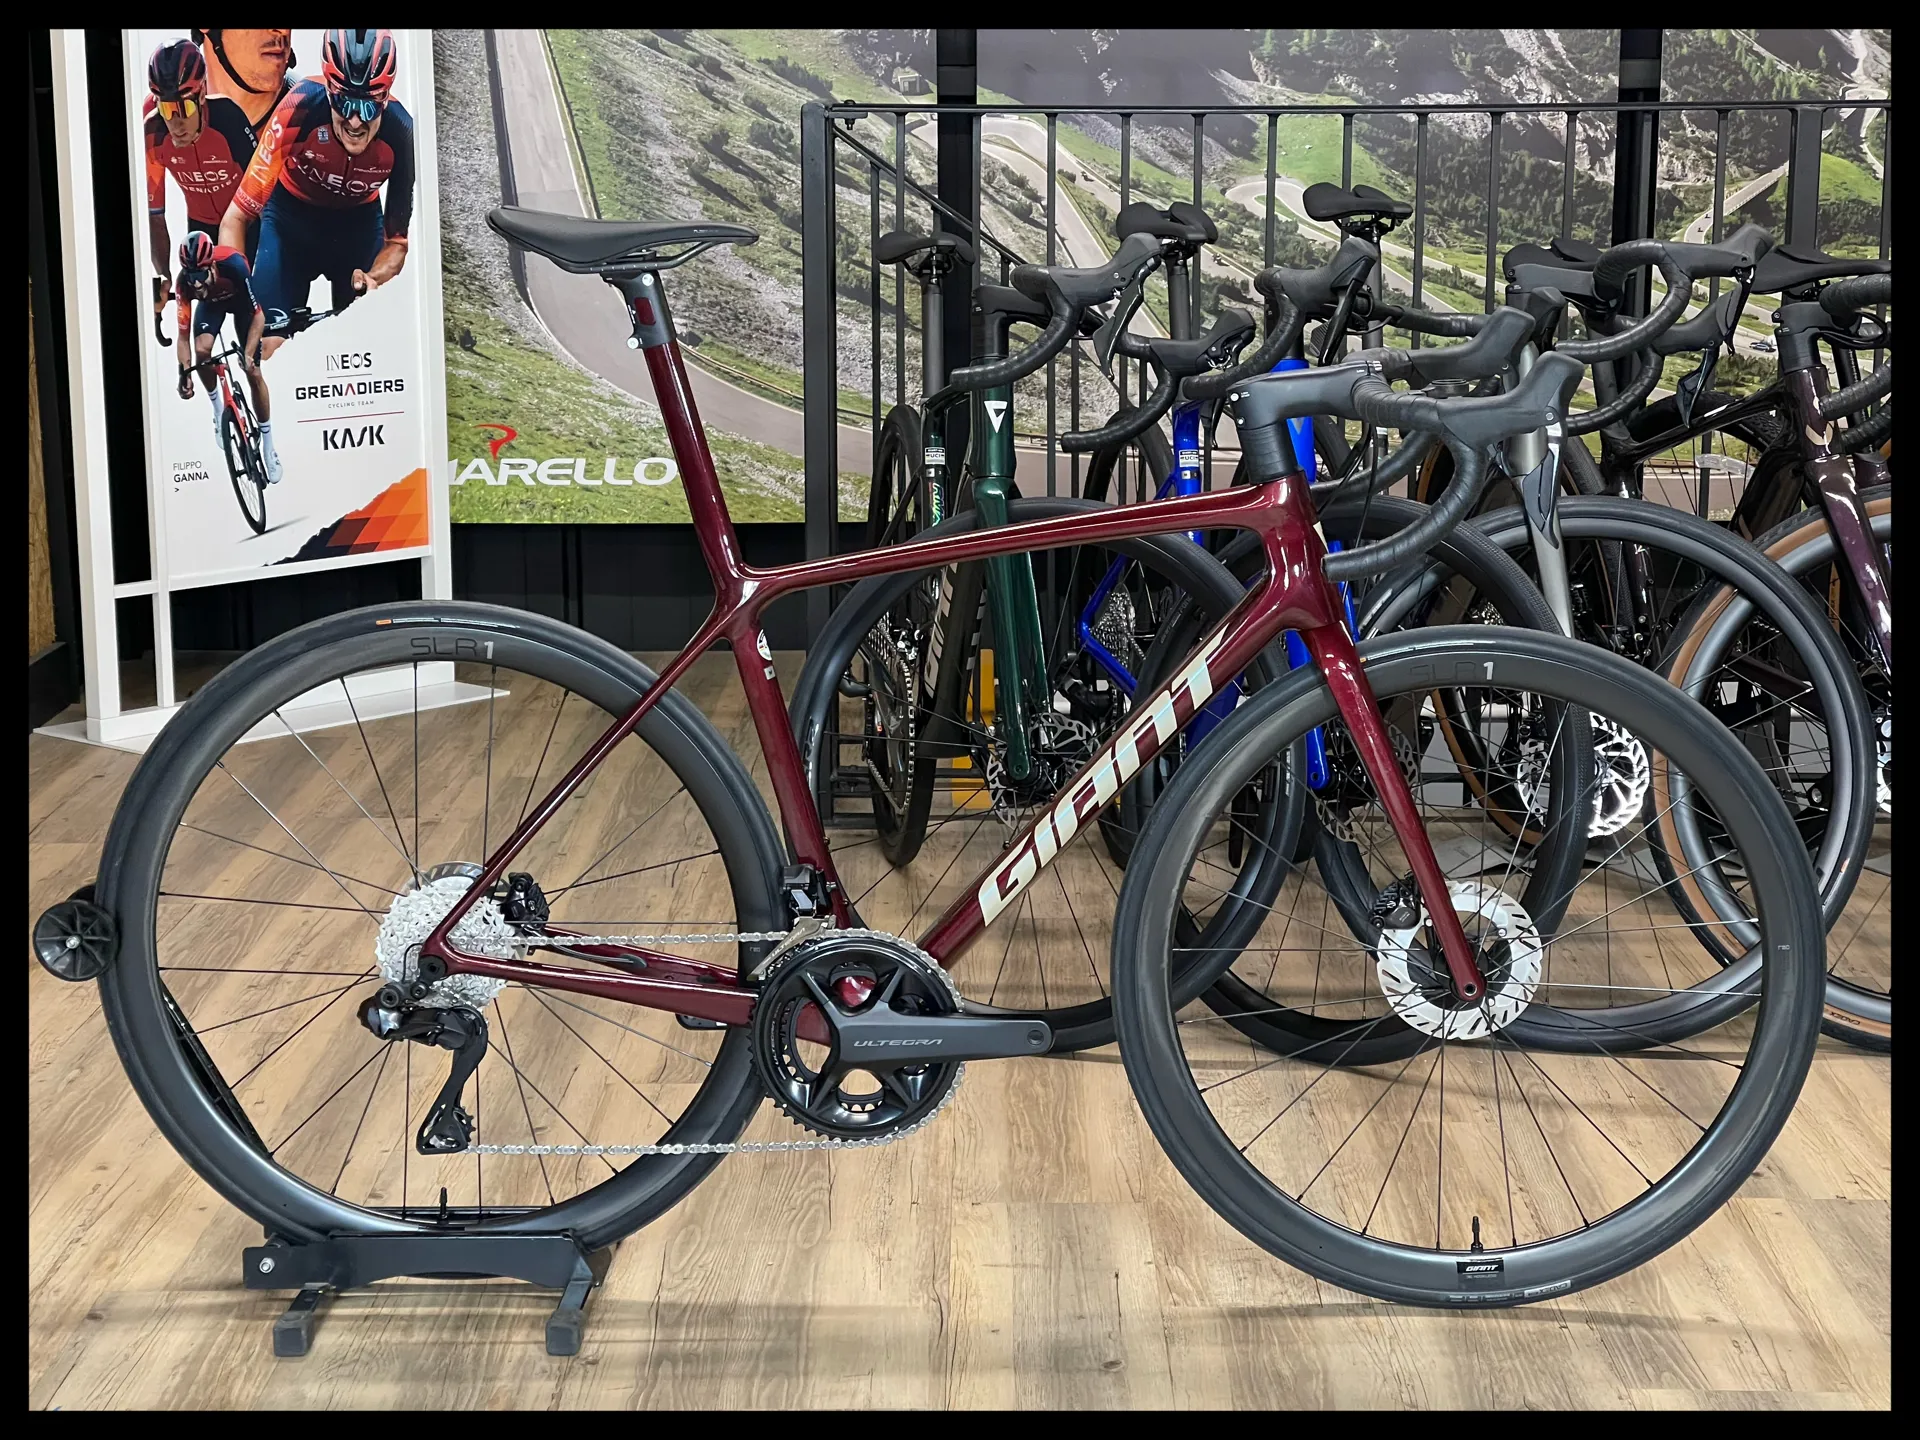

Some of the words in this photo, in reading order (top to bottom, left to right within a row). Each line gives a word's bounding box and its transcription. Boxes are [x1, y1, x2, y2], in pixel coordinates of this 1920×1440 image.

[177, 169, 229, 182] INEOS
[326, 352, 372, 371] INEOS
[295, 379, 404, 400] GRENADIERS
[328, 401, 356, 409] CYCLING
[322, 424, 385, 451] KASK
[173, 460, 202, 471] FILIPPO
[173, 471, 209, 483] GANNA
[411, 637, 477, 656] SLR
[484, 641, 494, 660] 1
[1483, 661, 1494, 681] 1
[978, 622, 1231, 927] GIANT
[853, 1038, 944, 1048] ULTEGRA
[1465, 1264, 1499, 1272] GIANT
